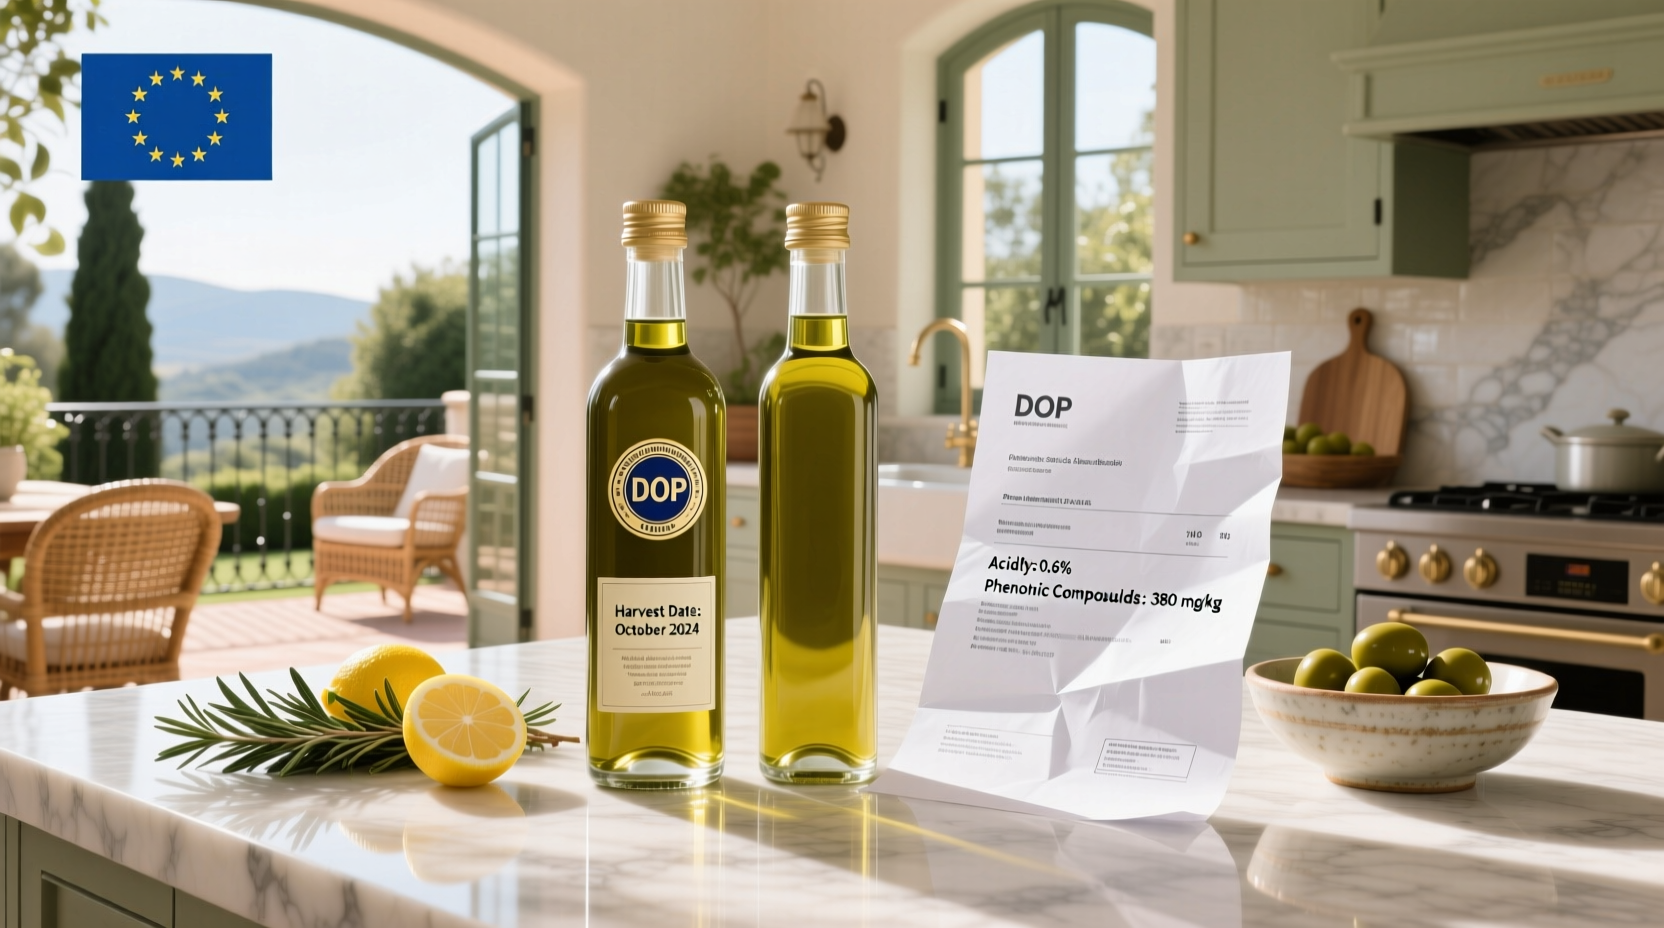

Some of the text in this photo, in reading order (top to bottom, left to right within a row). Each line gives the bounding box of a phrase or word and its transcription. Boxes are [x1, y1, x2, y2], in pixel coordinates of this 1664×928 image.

[1014, 393, 1073, 419] DOP
[632, 476, 688, 503] DOP
[1039, 559, 1072, 575] 0.6%
[1150, 591, 1178, 607] 380
[615, 604, 702, 618] Harvest Date:
[615, 622, 700, 636] October 2024
